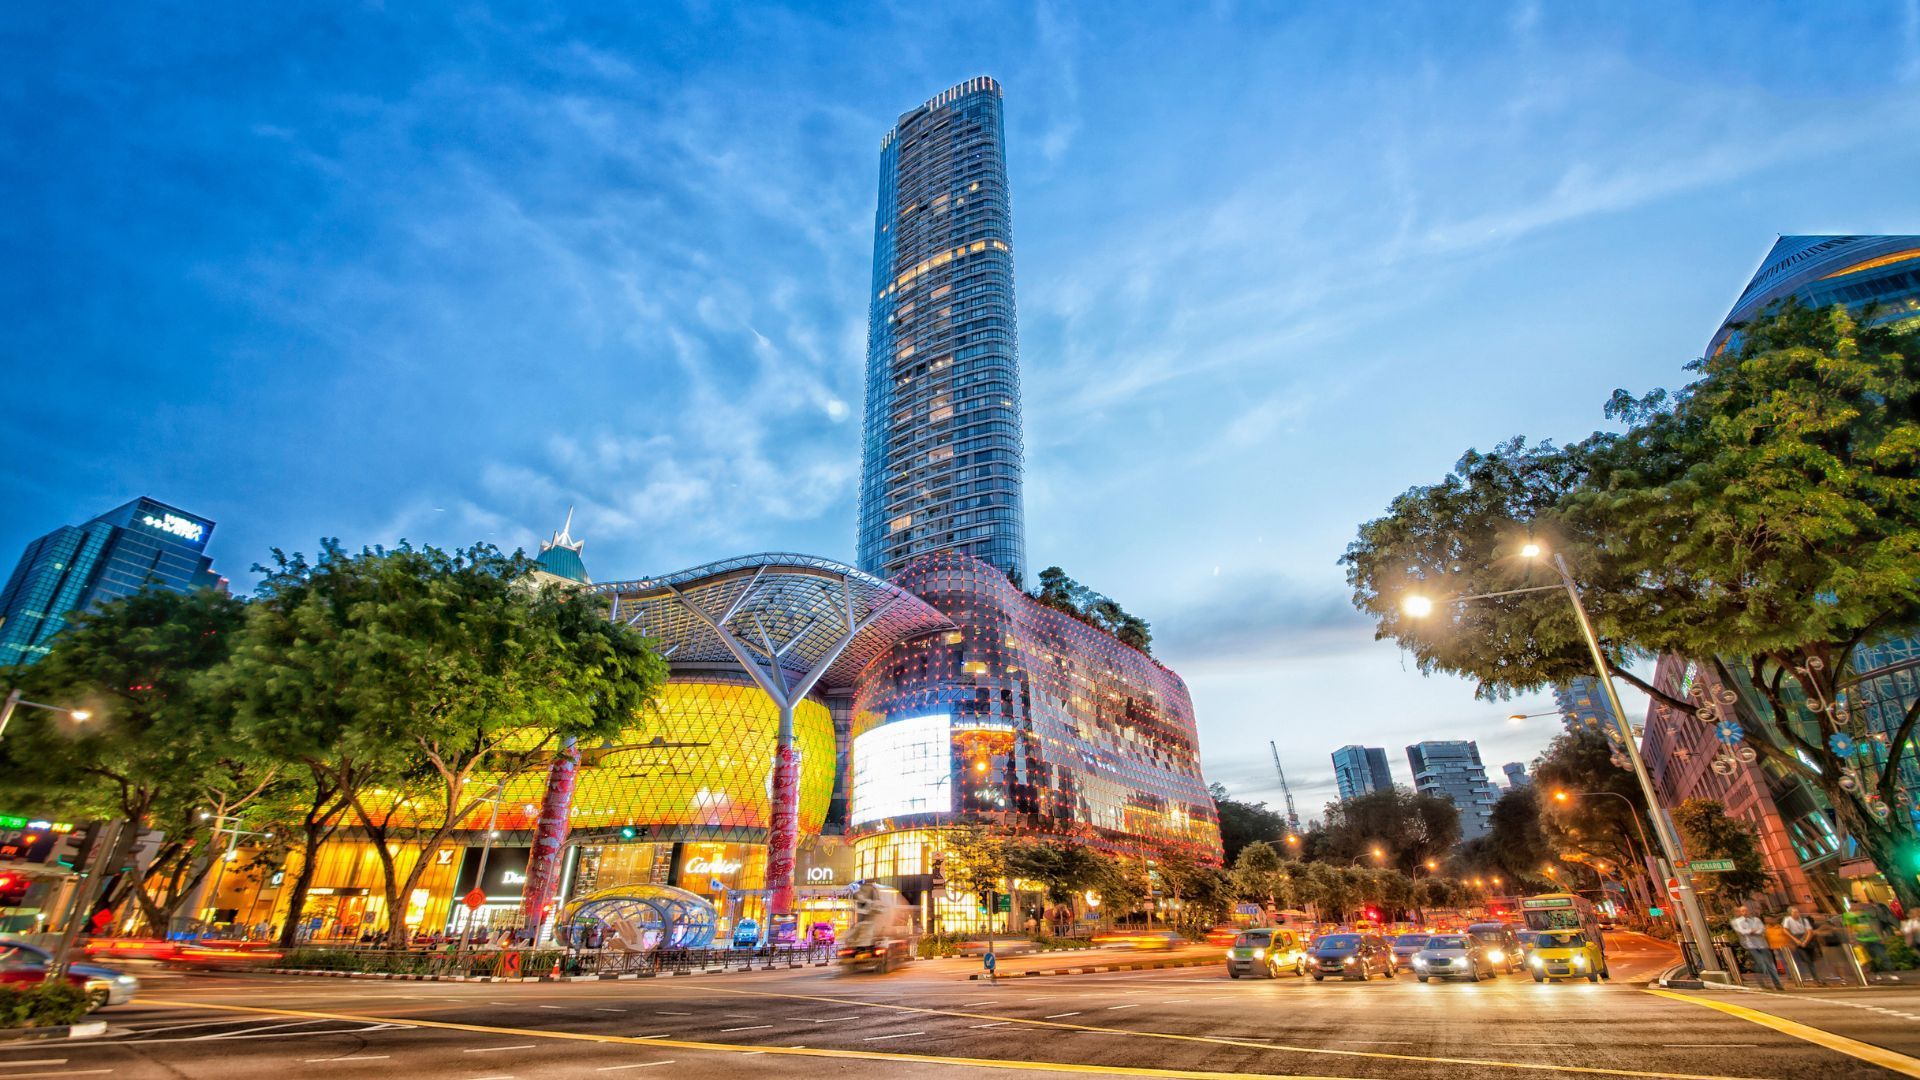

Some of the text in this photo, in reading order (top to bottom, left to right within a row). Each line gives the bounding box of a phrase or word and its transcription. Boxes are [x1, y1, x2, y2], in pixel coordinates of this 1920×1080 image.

[685, 857, 742, 873] Cartier
[1691, 861, 1732, 870] ORCHARD RD
